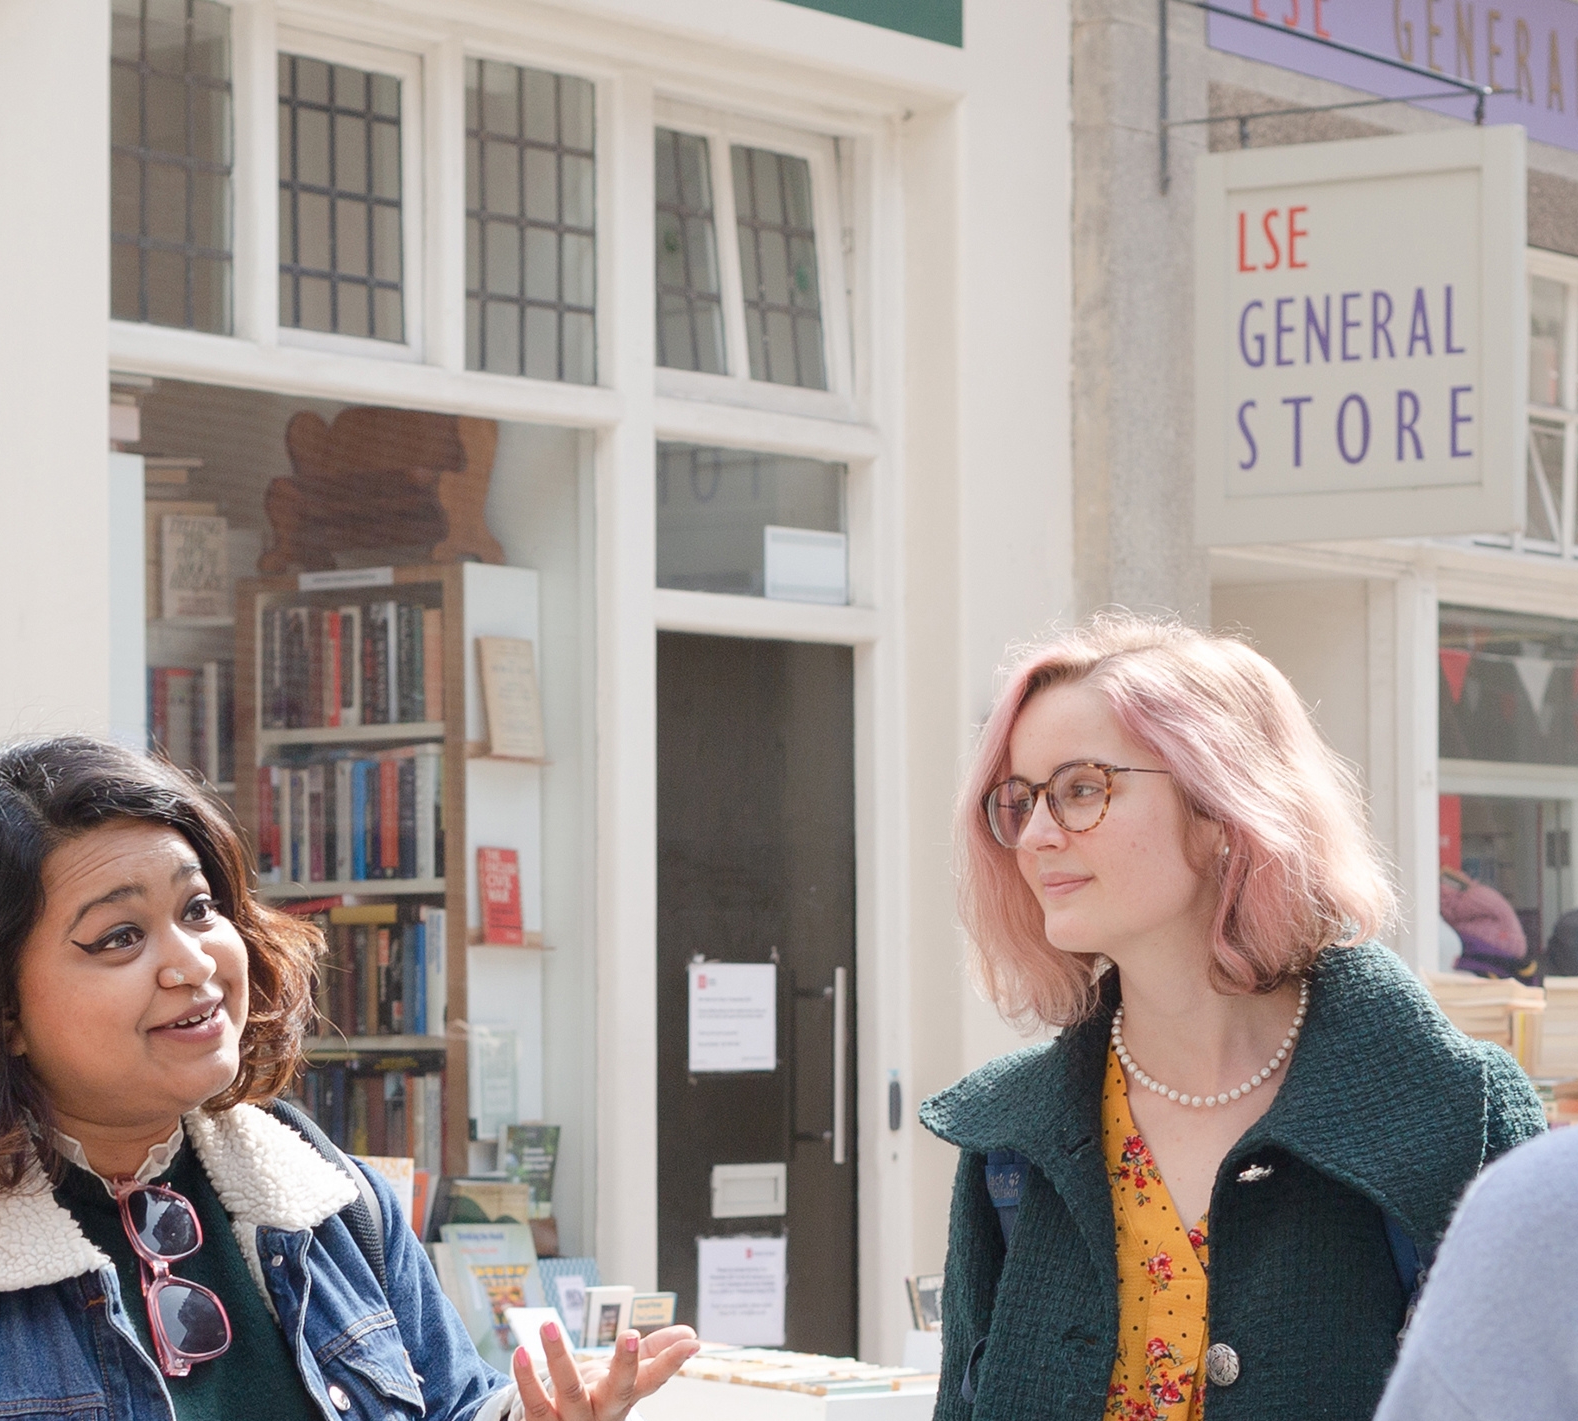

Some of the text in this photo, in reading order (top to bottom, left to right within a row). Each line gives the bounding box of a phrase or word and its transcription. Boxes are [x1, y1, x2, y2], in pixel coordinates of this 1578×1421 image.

[1238, 205, 1308, 273] LSE
[1239, 285, 1466, 368] GENERAL
[1237, 386, 1474, 471] STORE
